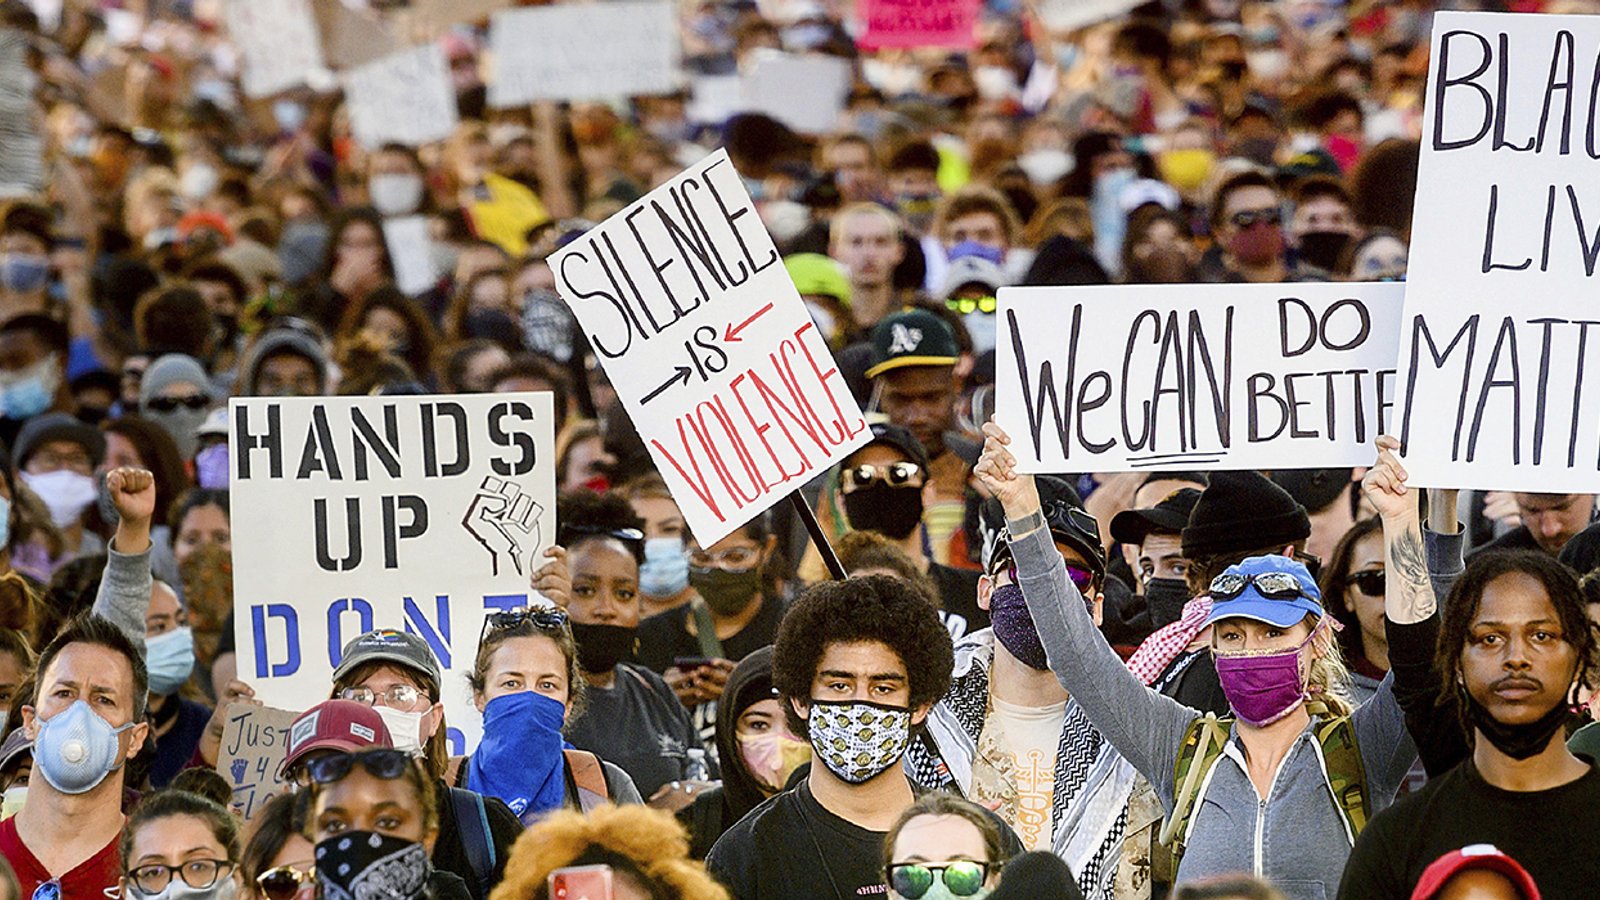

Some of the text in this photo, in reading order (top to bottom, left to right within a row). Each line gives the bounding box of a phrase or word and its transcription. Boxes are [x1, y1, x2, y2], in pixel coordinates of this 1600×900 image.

[561, 158, 777, 359] SILENCE
[651, 322, 866, 523] VIOLENCE
[684, 325, 728, 382] IS
[1121, 305, 1234, 453] CAN
[1278, 297, 1371, 358] DO
[1400, 313, 1600, 468] MATT
[235, 402, 536, 481] HANDS
[313, 494, 429, 572] UP
